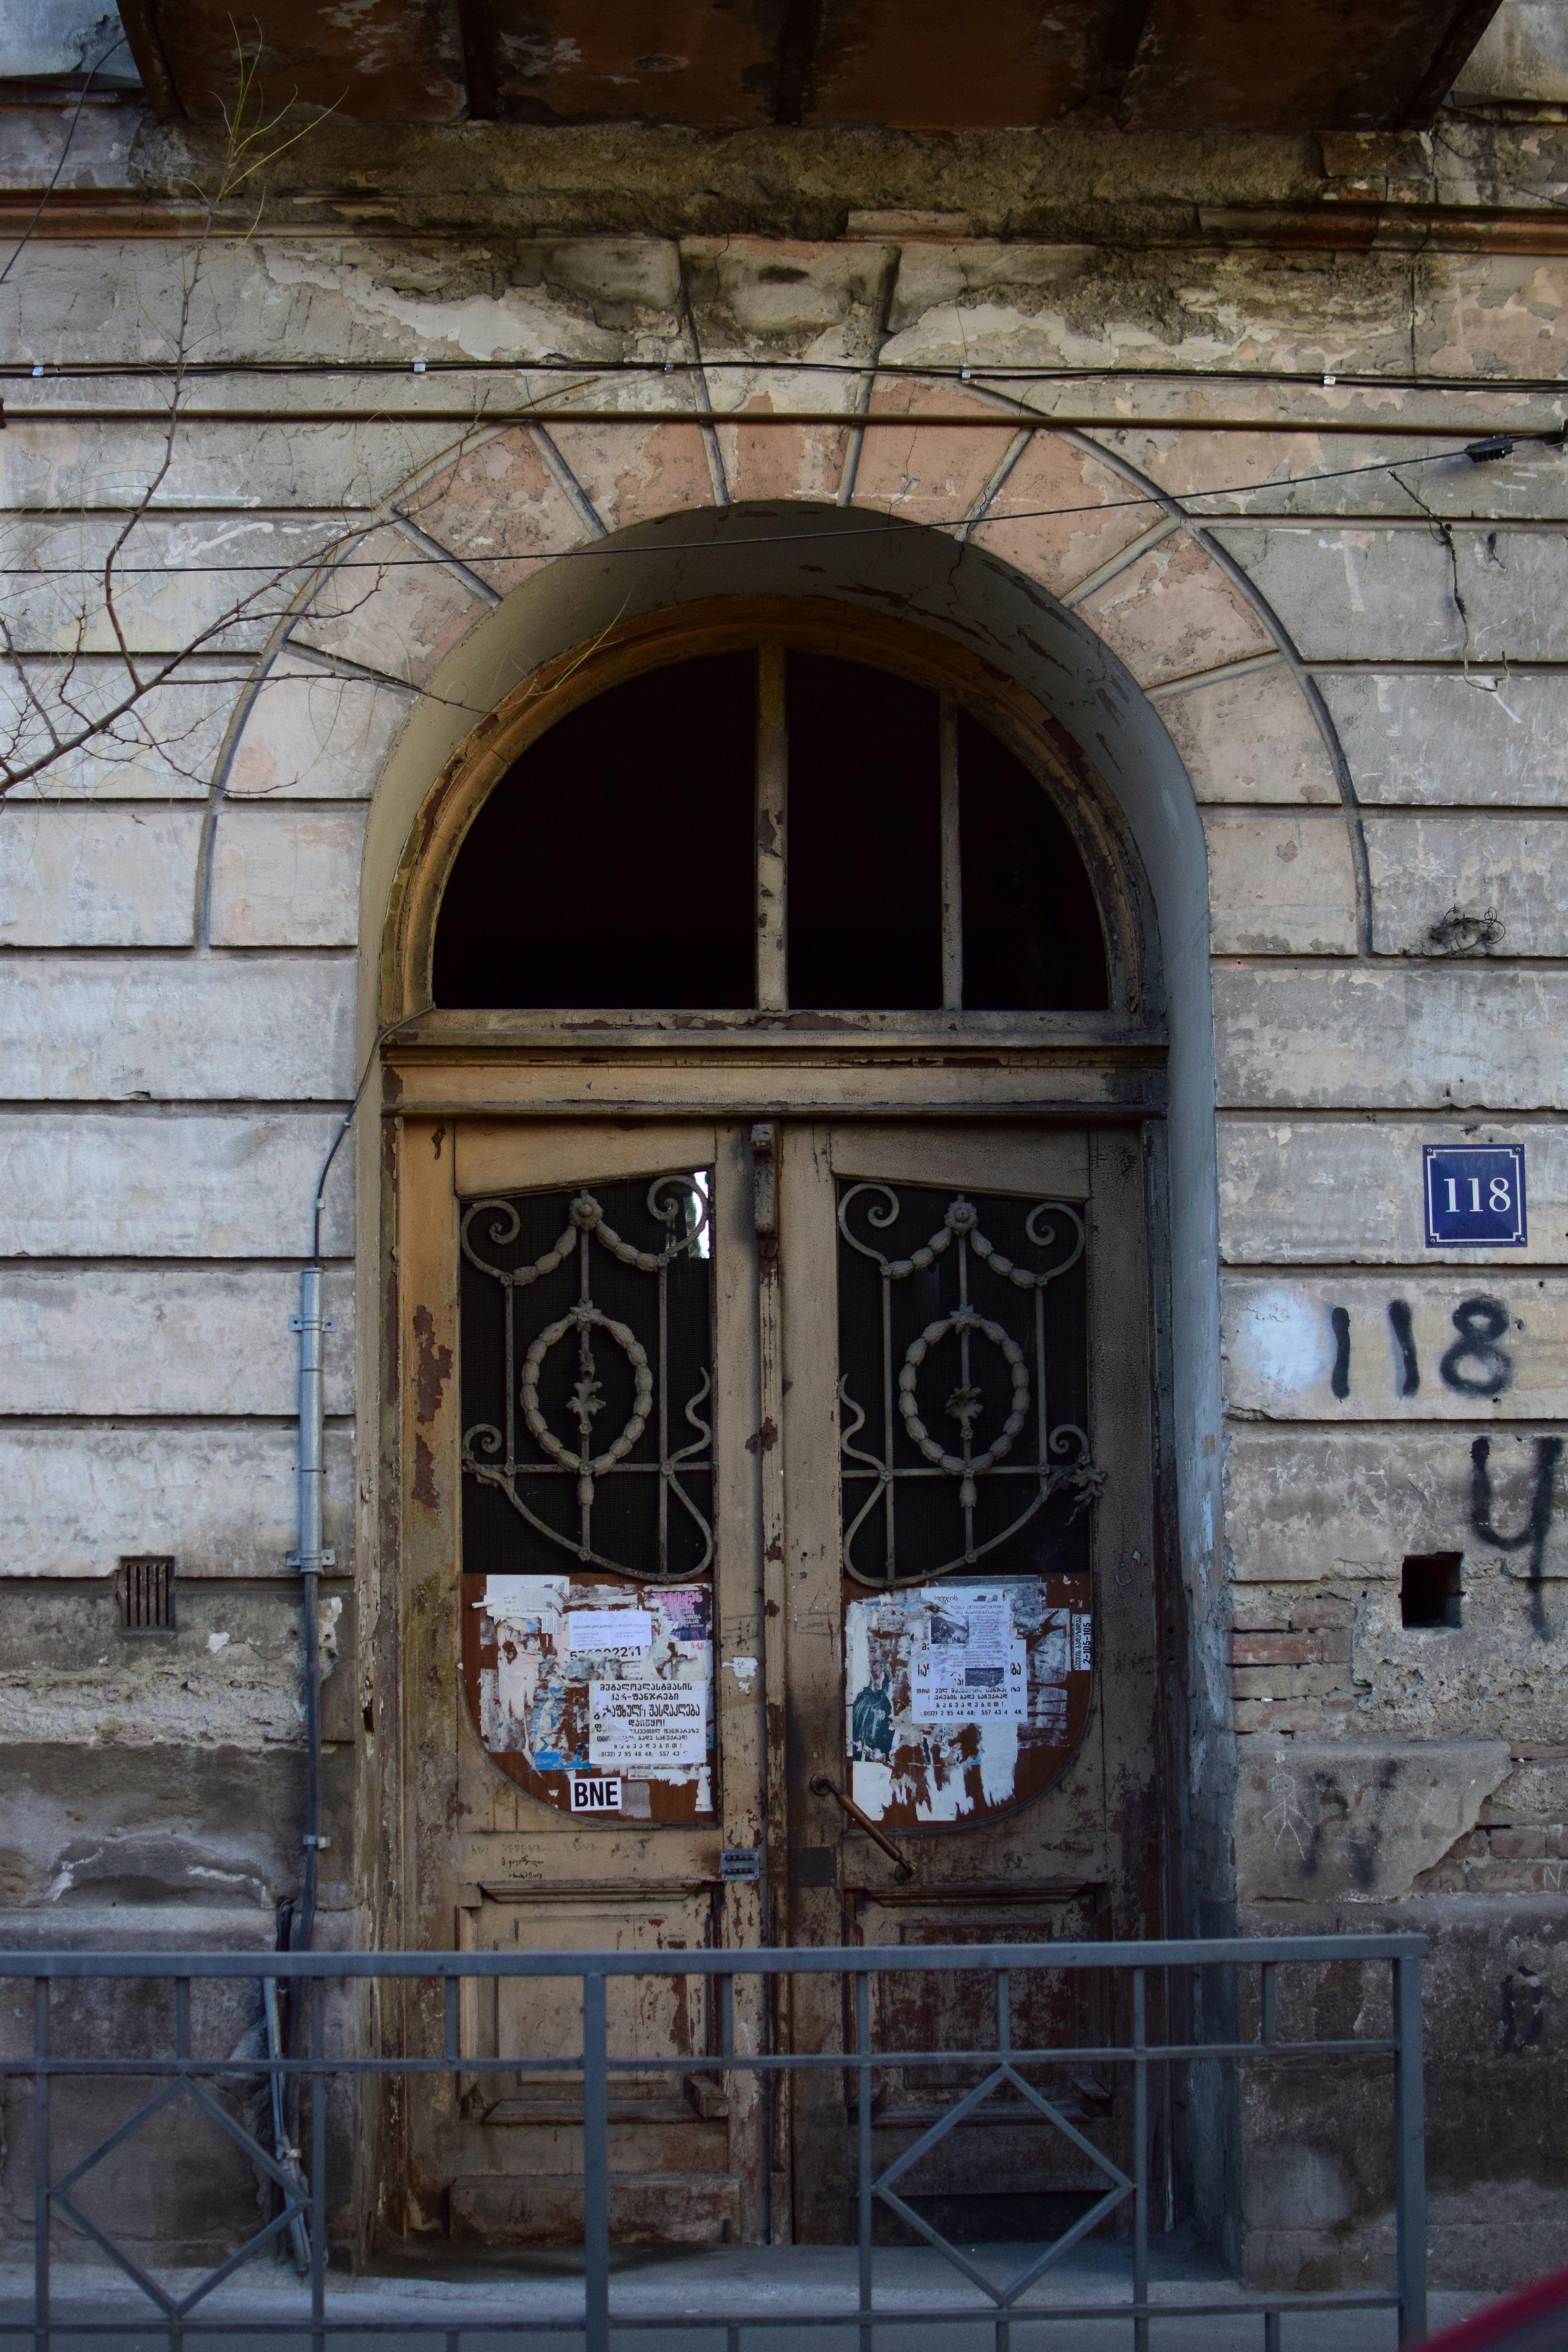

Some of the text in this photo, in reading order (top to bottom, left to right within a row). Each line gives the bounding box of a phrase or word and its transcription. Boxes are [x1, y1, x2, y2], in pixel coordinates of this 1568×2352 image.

[1443, 1178, 1510, 1212] 118
[1330, 1296, 1512, 1399] 118
[1083, 1622, 1091, 1664] 2-105-105
[574, 1781, 618, 1807] BNE
